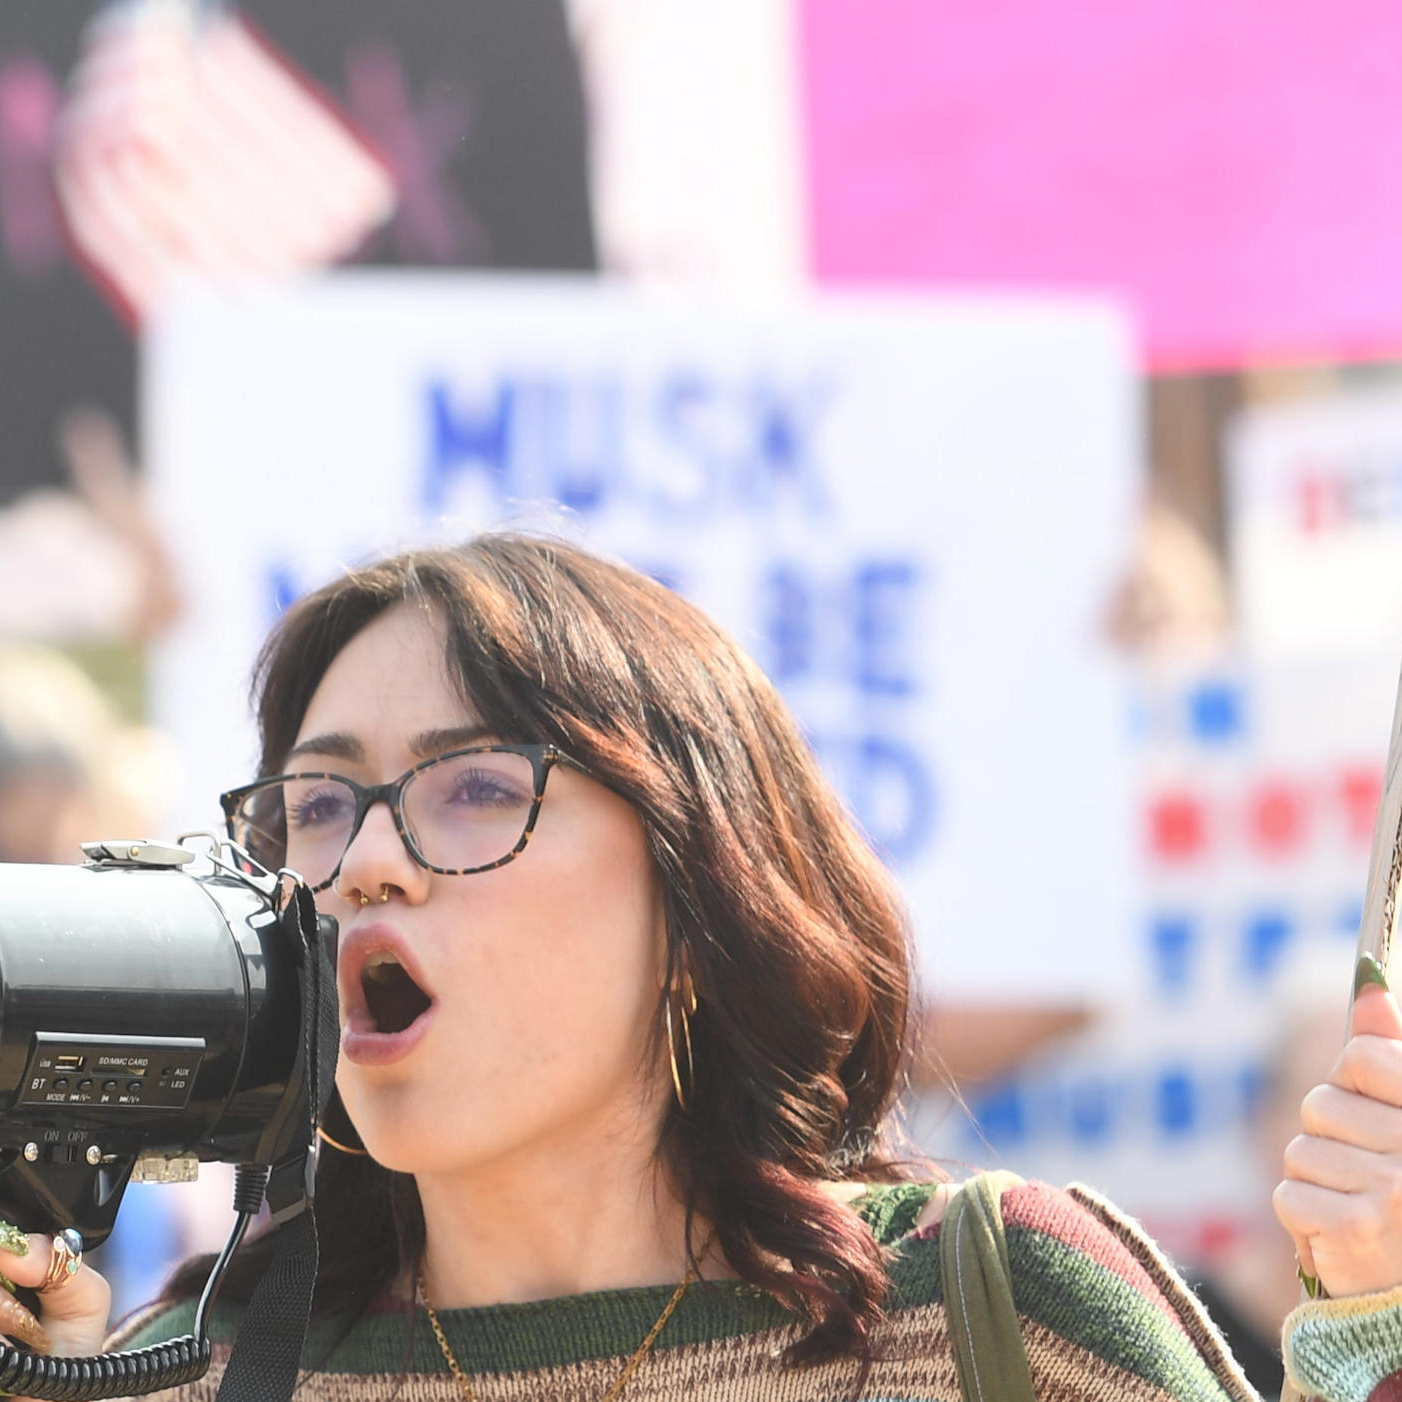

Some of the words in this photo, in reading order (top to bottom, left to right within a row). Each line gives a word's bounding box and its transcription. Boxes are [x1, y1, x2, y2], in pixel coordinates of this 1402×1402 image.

[418, 360, 840, 516] MUSK
[98, 1057, 127, 1066] SD/MMC
[128, 1057, 148, 1066] CARD
[174, 1068, 190, 1077] AUX
[31, 1078, 47, 1090] BT
[171, 1081, 185, 1089] LED
[46, 1093, 66, 1102] MODE
[44, 1130, 60, 1142] ON
[67, 1131, 88, 1142] OFF
